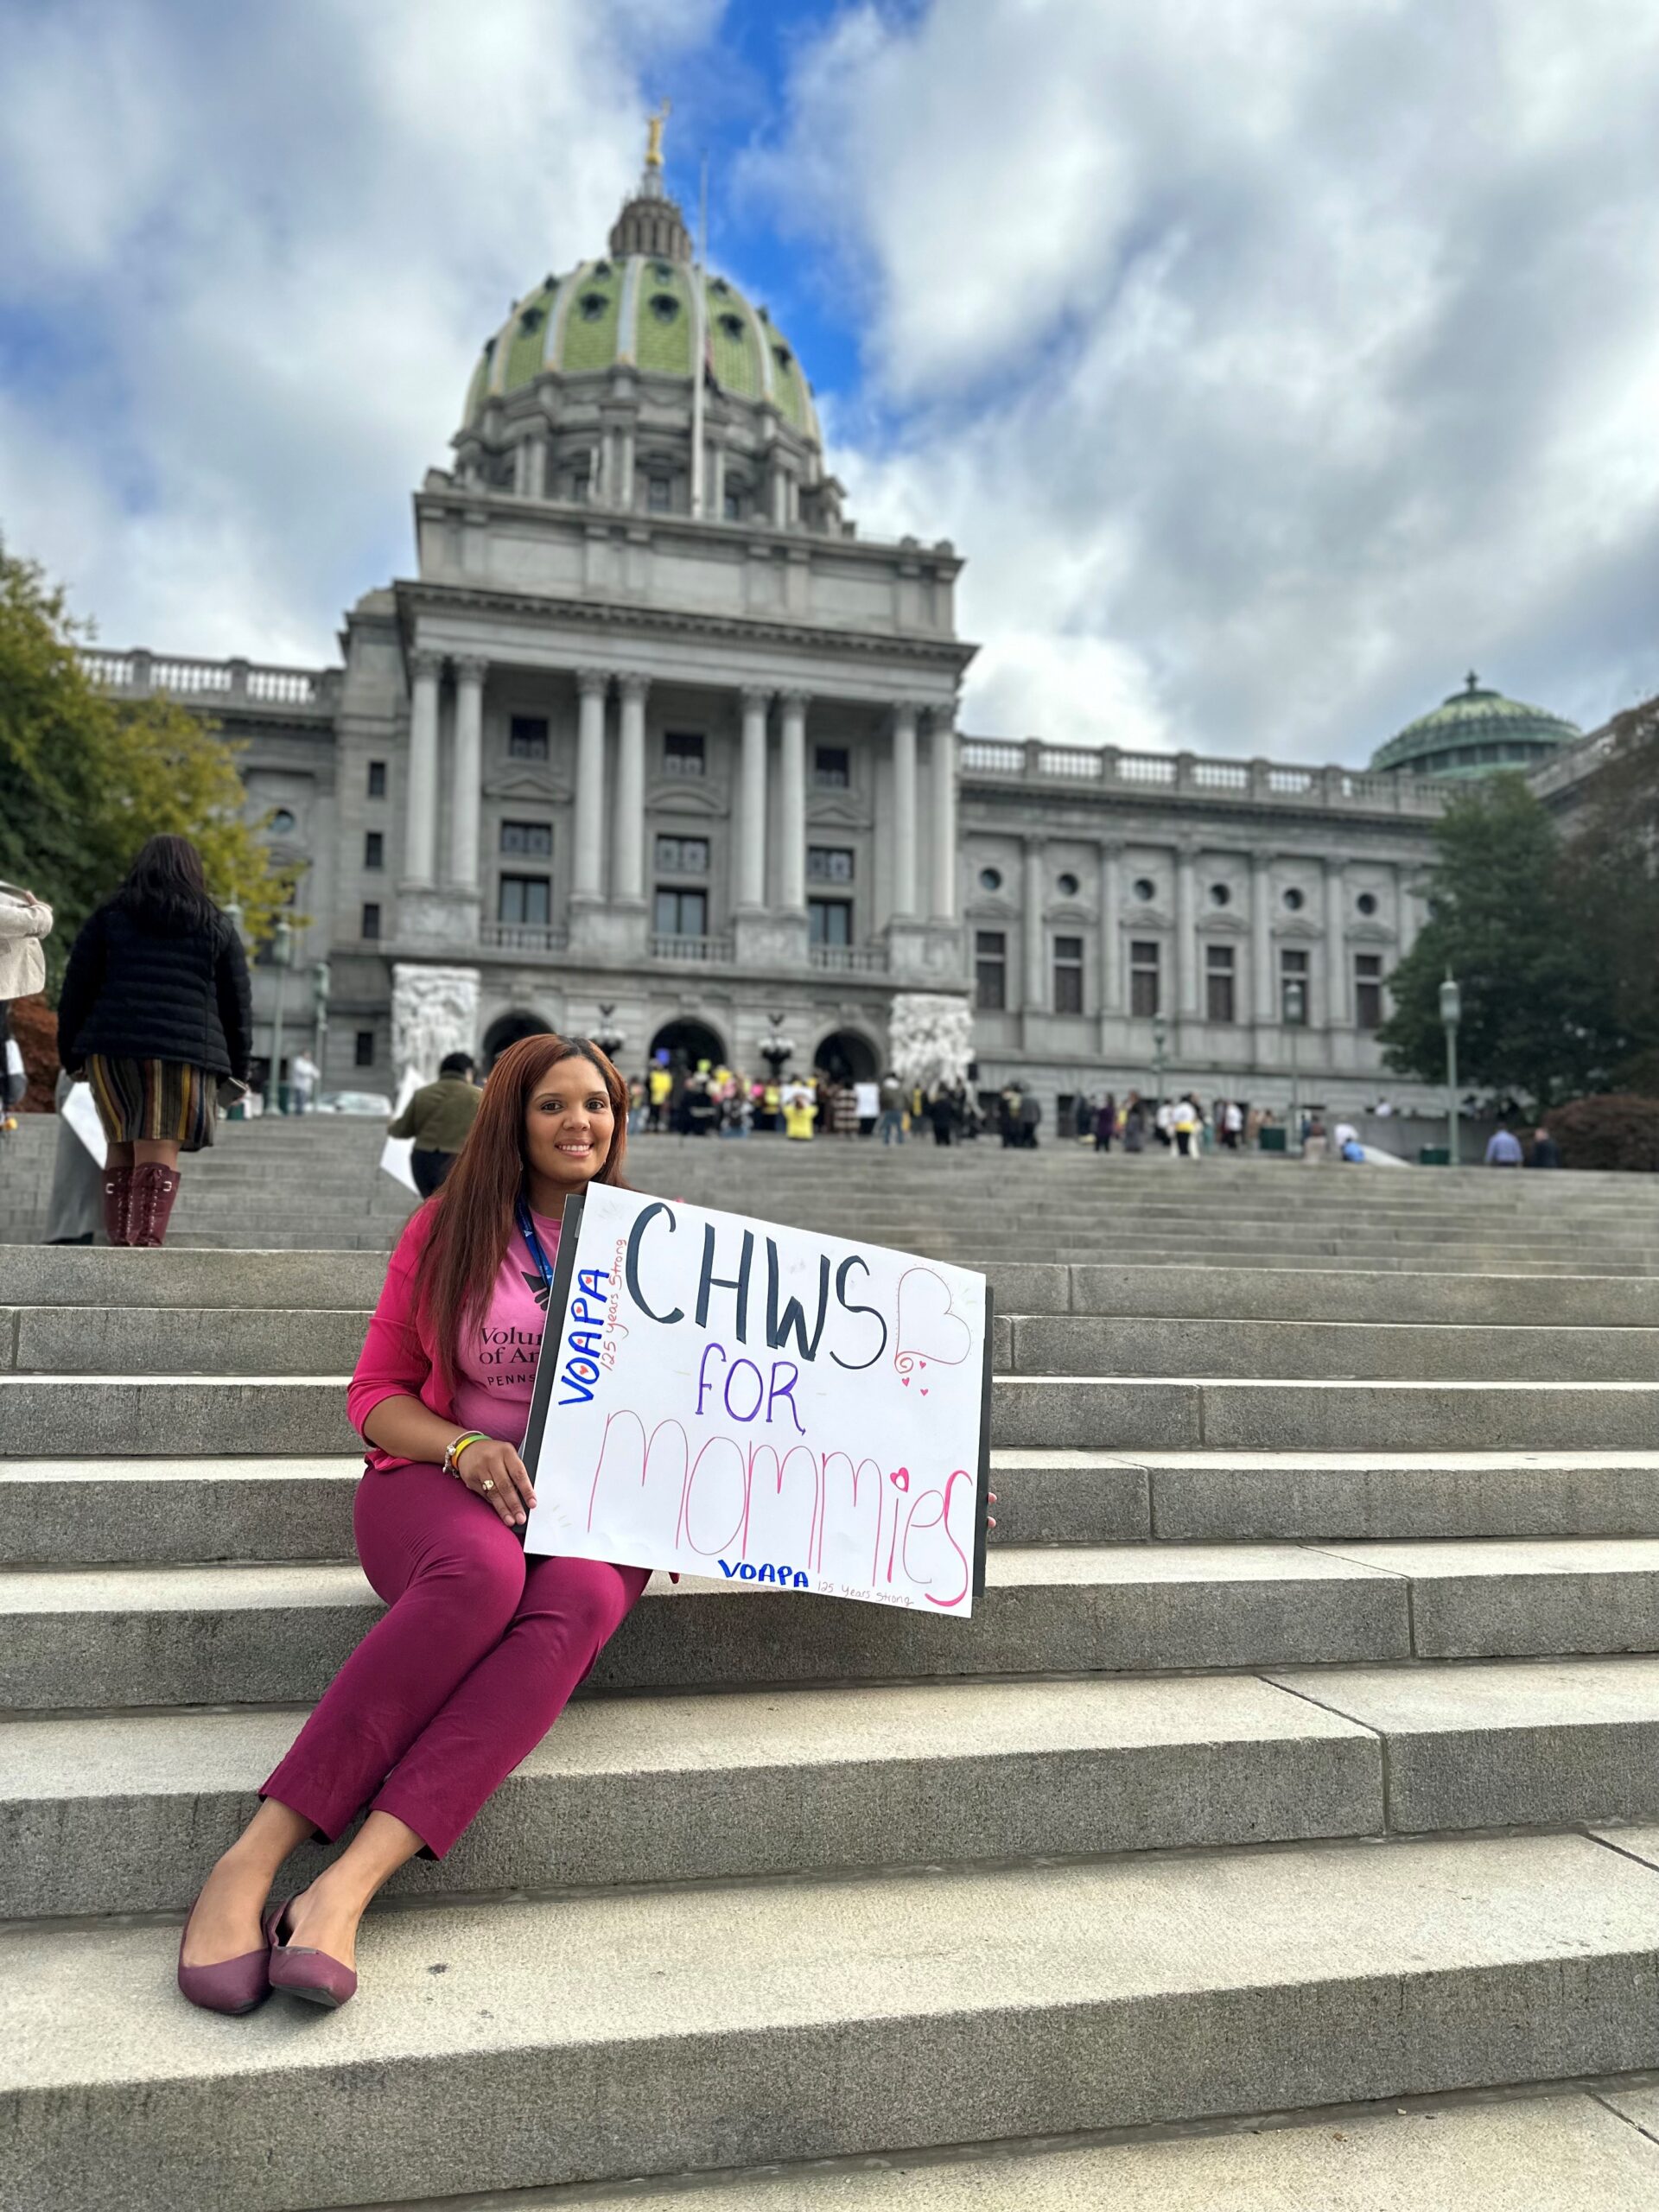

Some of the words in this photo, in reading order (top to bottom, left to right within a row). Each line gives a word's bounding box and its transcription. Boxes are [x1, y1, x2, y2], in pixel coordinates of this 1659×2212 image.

[625, 1202, 887, 1370] CHWS
[558, 1269, 609, 1405] VOAPA
[479, 1347, 505, 1365] of
[600, 1341, 616, 1371] 125
[695, 1342, 806, 1436] FOR
[717, 1559, 810, 1588] VOAPA
[817, 1580, 835, 1594] 125
